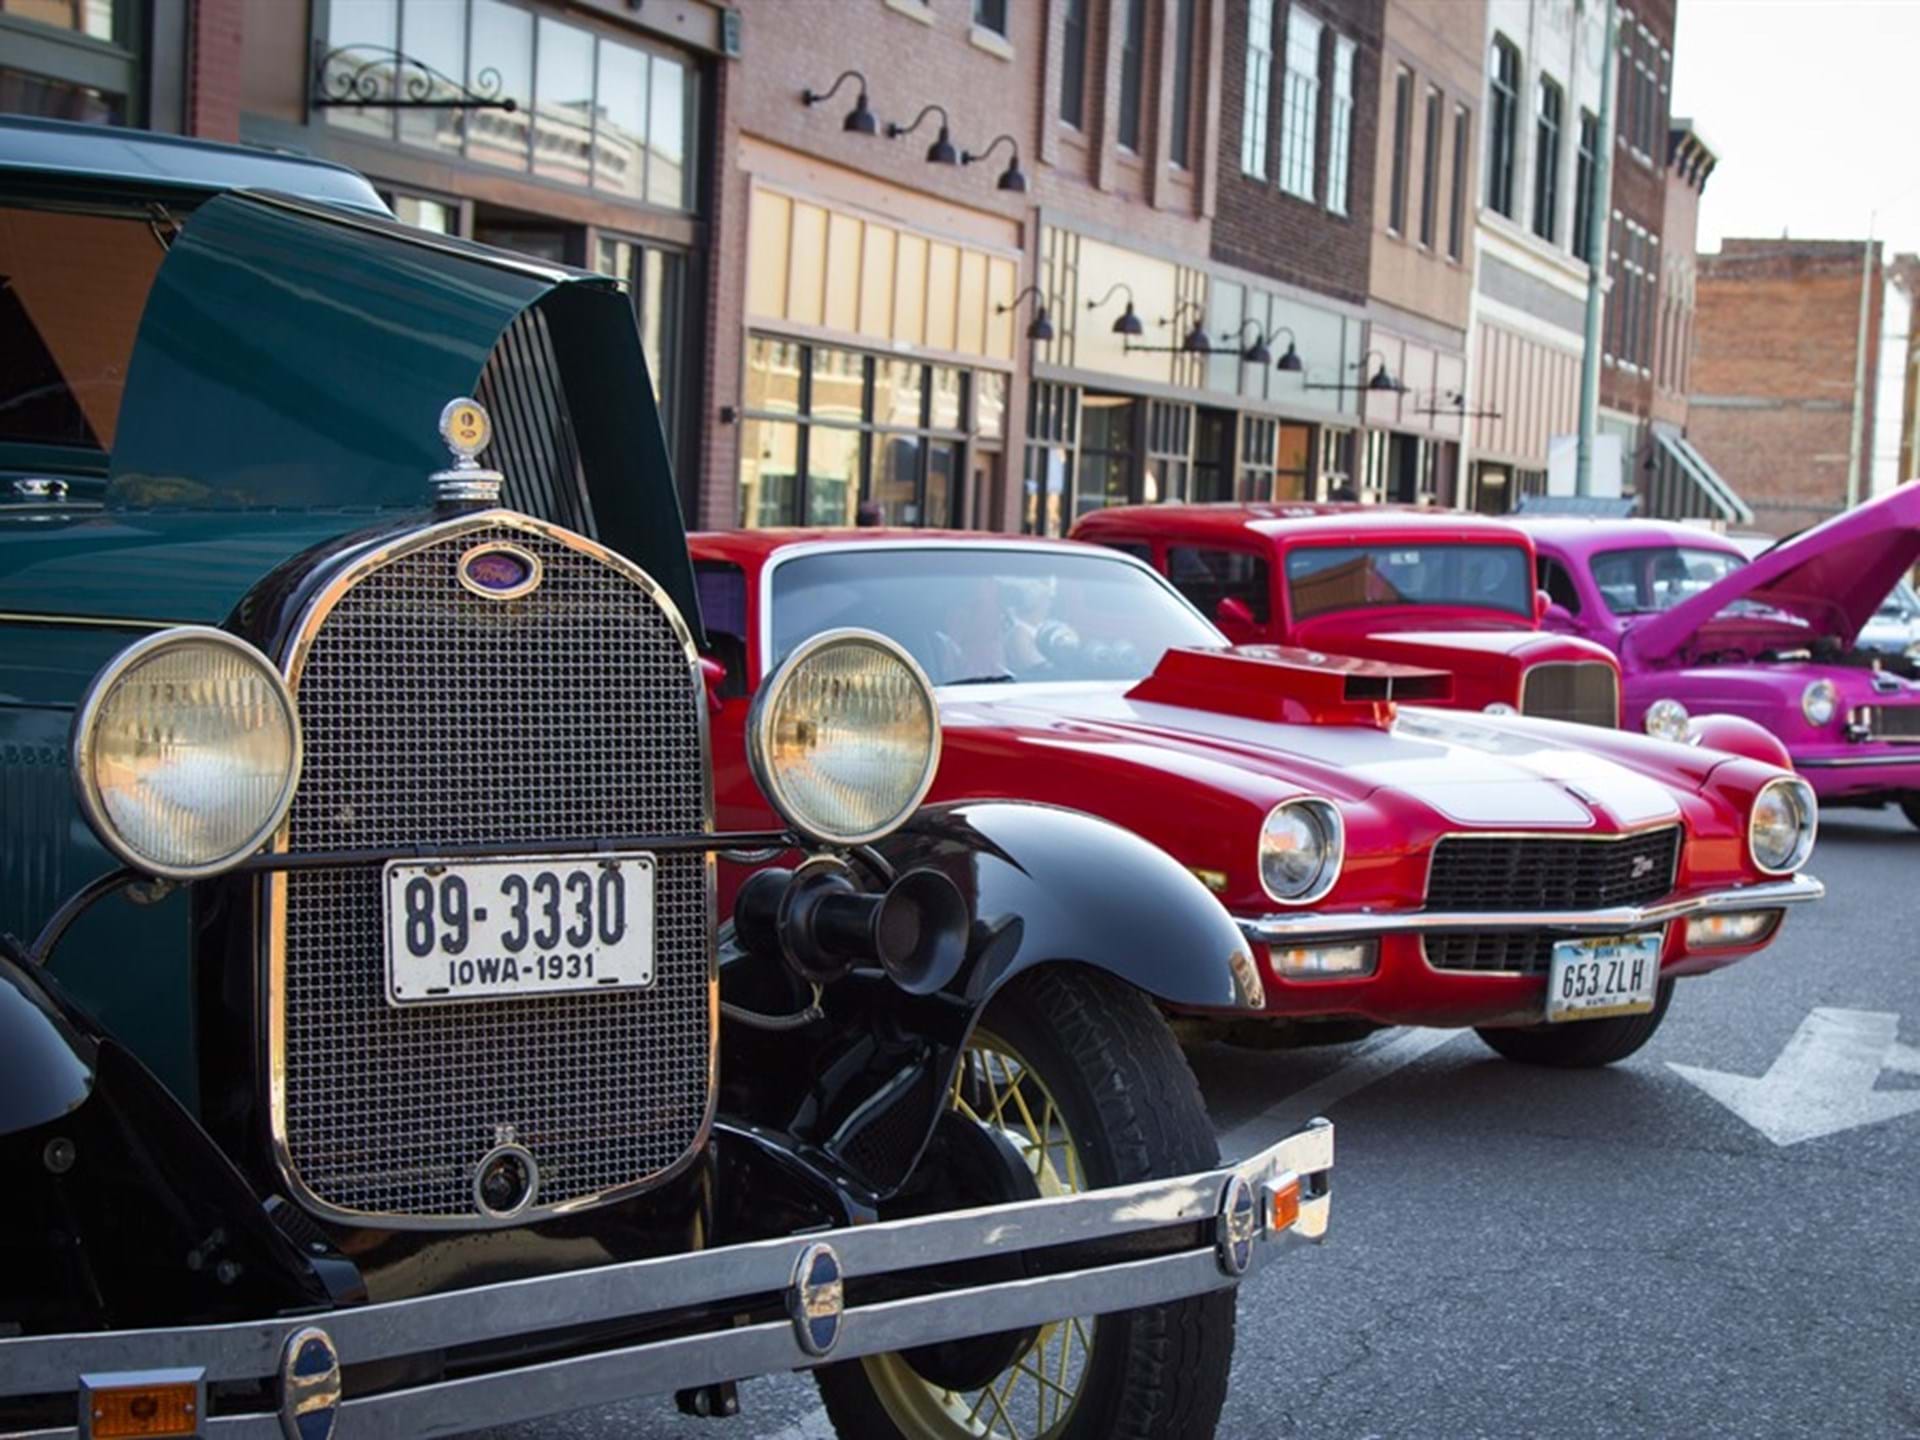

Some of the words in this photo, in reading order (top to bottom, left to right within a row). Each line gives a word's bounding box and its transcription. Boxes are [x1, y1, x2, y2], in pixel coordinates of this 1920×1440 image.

[405, 871, 625, 957] 89-3330
[450, 954, 594, 985] IOWA-1931
[1562, 964, 1600, 999] 653
[1605, 959, 1645, 994] ZLH
